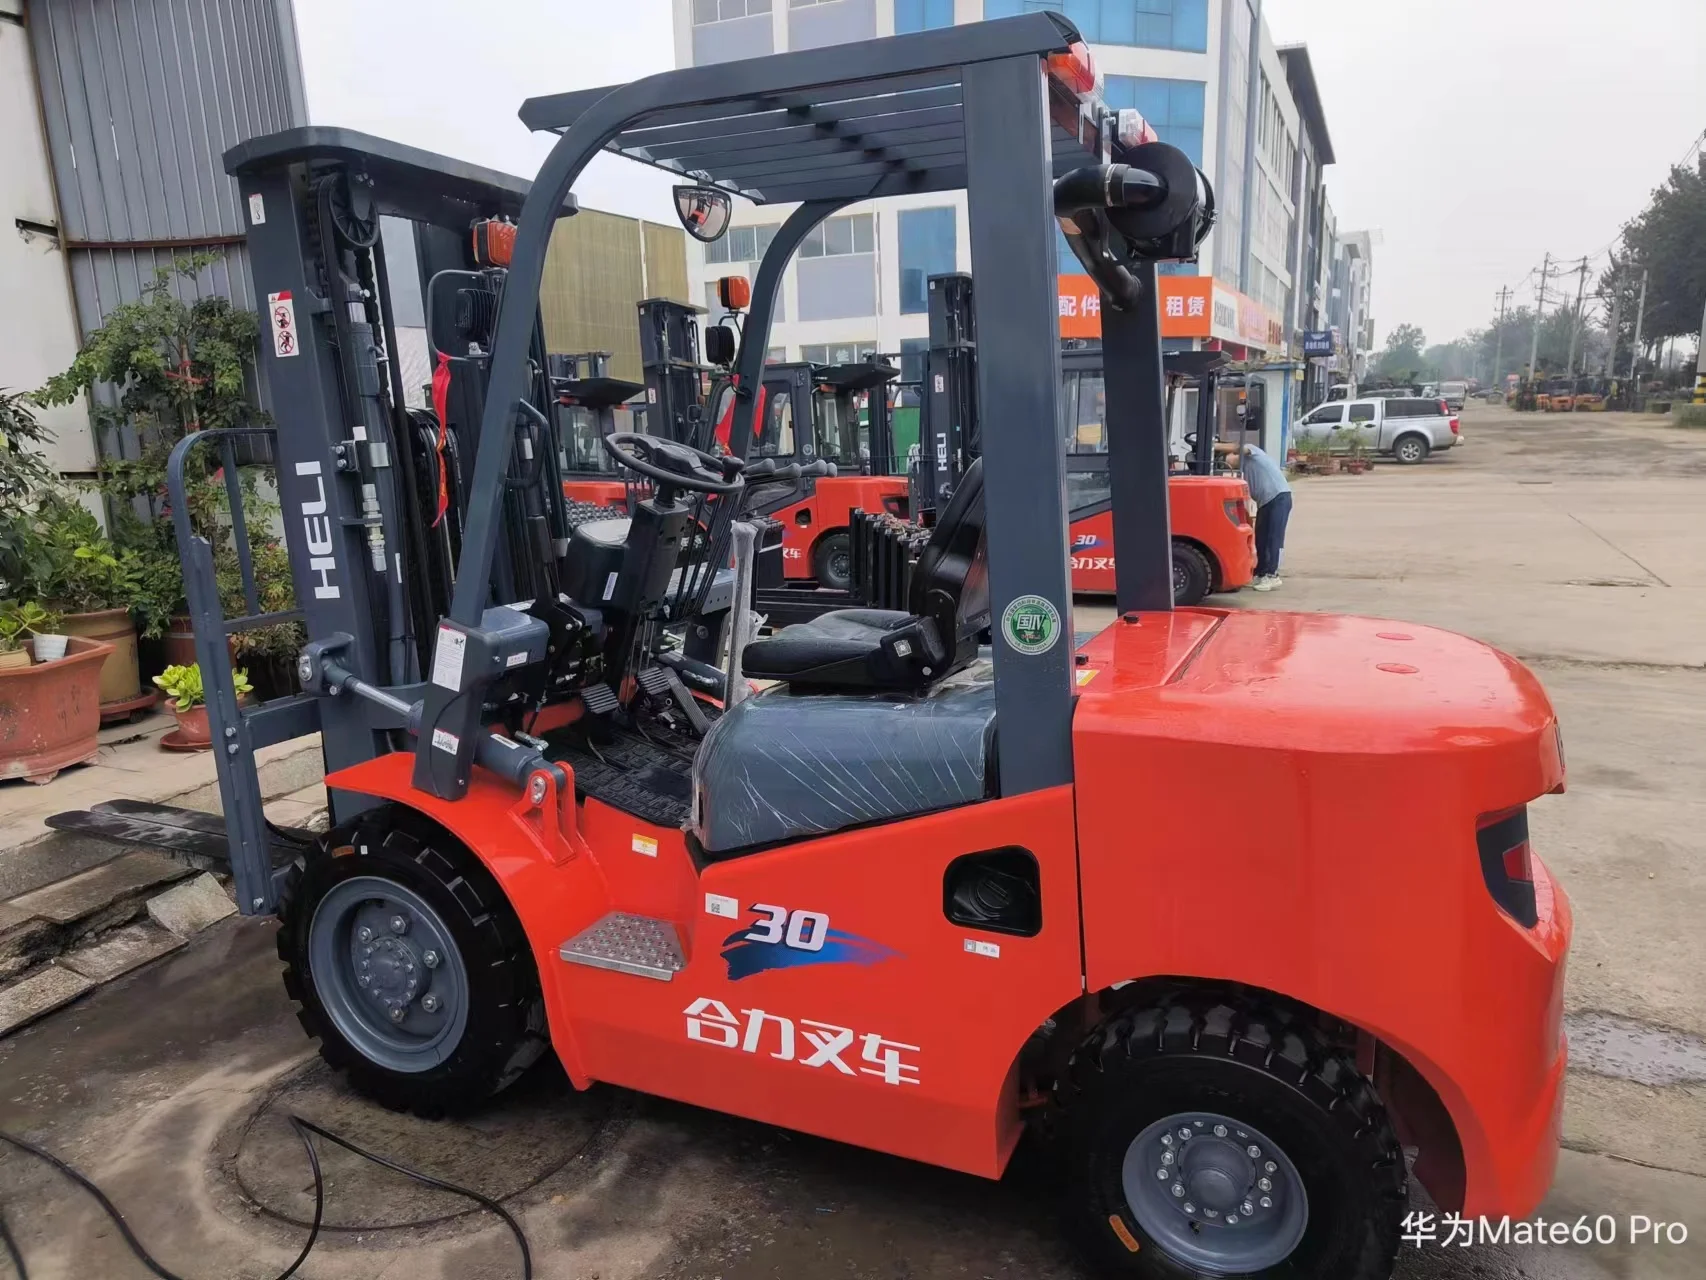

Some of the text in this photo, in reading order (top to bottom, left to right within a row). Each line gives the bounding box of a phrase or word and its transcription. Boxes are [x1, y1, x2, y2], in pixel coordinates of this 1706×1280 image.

[1166, 296, 1205, 316] 租赁
[936, 433, 948, 471] HELI
[295, 461, 340, 599] HELI
[1075, 534, 1097, 546] 30
[744, 903, 830, 952] 30
[683, 997, 921, 1086] 合力叉车
